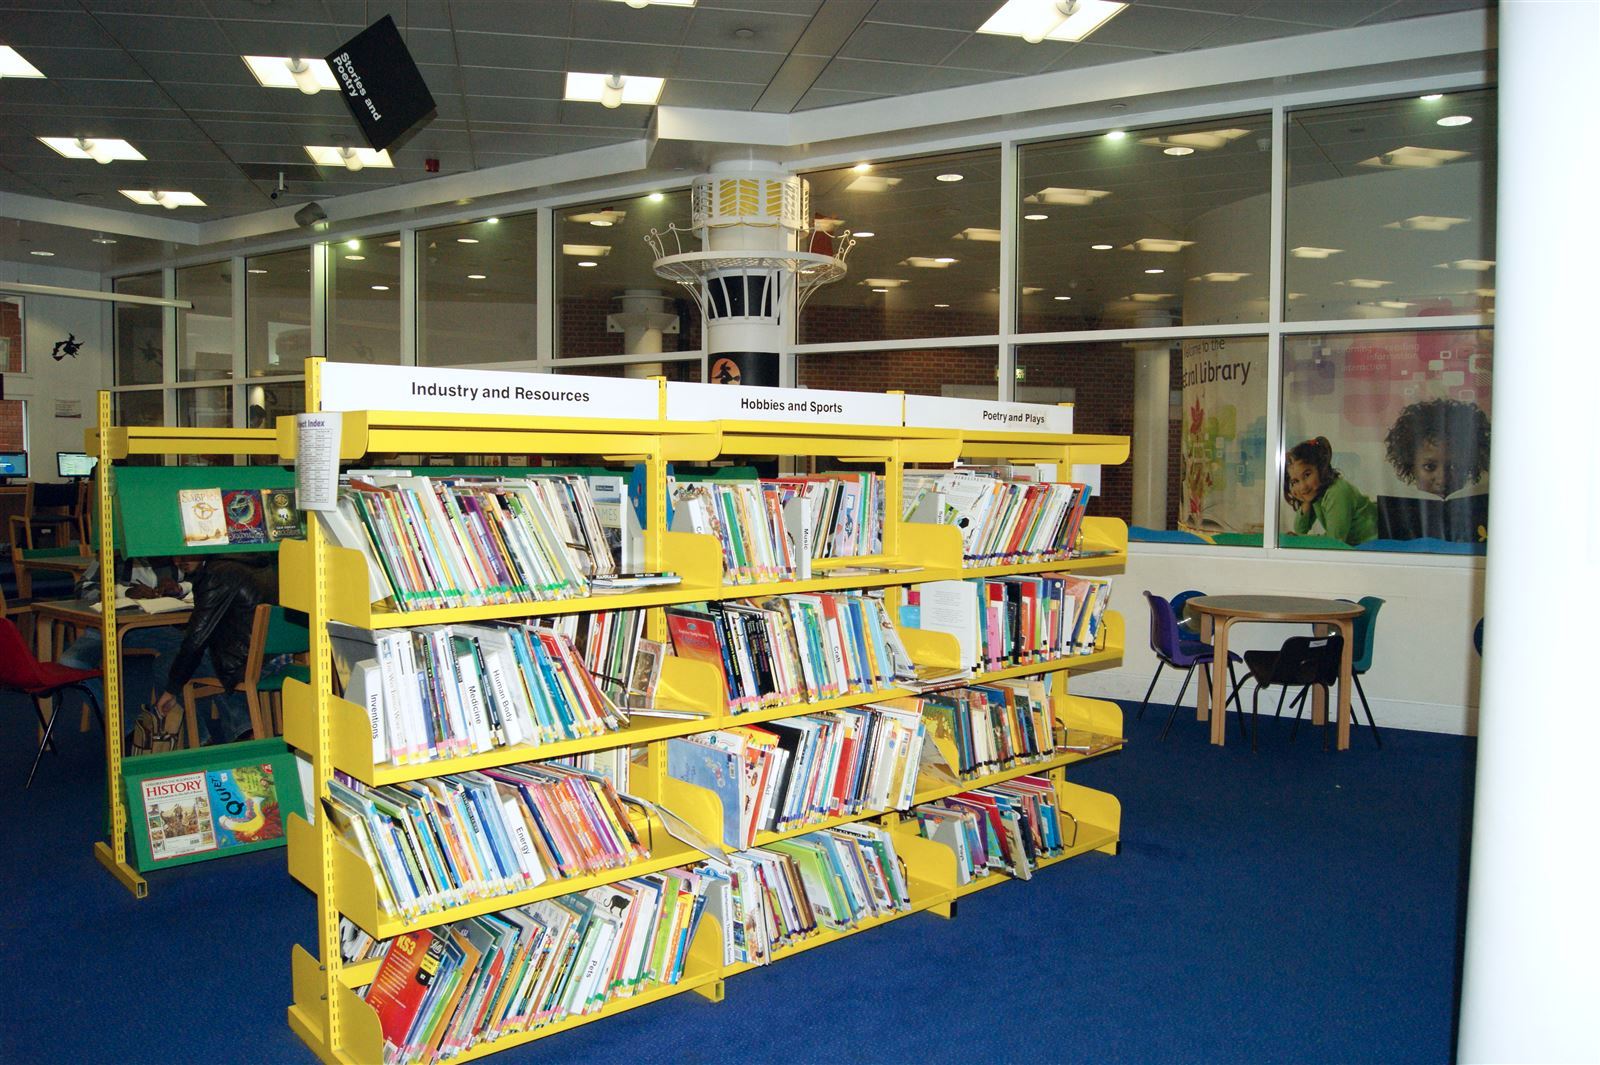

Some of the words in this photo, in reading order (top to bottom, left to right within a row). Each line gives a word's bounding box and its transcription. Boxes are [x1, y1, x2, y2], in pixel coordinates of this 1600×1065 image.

[333, 56, 359, 97] Poetry
[340, 52, 367, 96] Stories
[364, 98, 382, 121] and
[1211, 338, 1225, 352] the
[1200, 360, 1251, 386] Library
[411, 381, 478, 401] Industry
[482, 384, 510, 399] and
[515, 386, 590, 403] Resources
[741, 397, 785, 412] Hobbies
[788, 399, 807, 412] and
[810, 401, 843, 415] Sports
[308, 418, 325, 427] Index
[983, 410, 1008, 423] Poetry
[1008, 412, 1022, 422] and
[1025, 413, 1046, 425] Plays
[833, 646, 841, 663] Craft
[468, 685, 482, 725] Medicine
[493, 669, 505, 699] Human
[503, 699, 513, 722] Body
[370, 693, 379, 739] Inventions
[146, 780, 202, 797] HISTORY
[764, 783, 773, 795] Art
[515, 826, 530, 855] Energy
[396, 936, 416, 955] KS3
[586, 960, 598, 978] Pets
